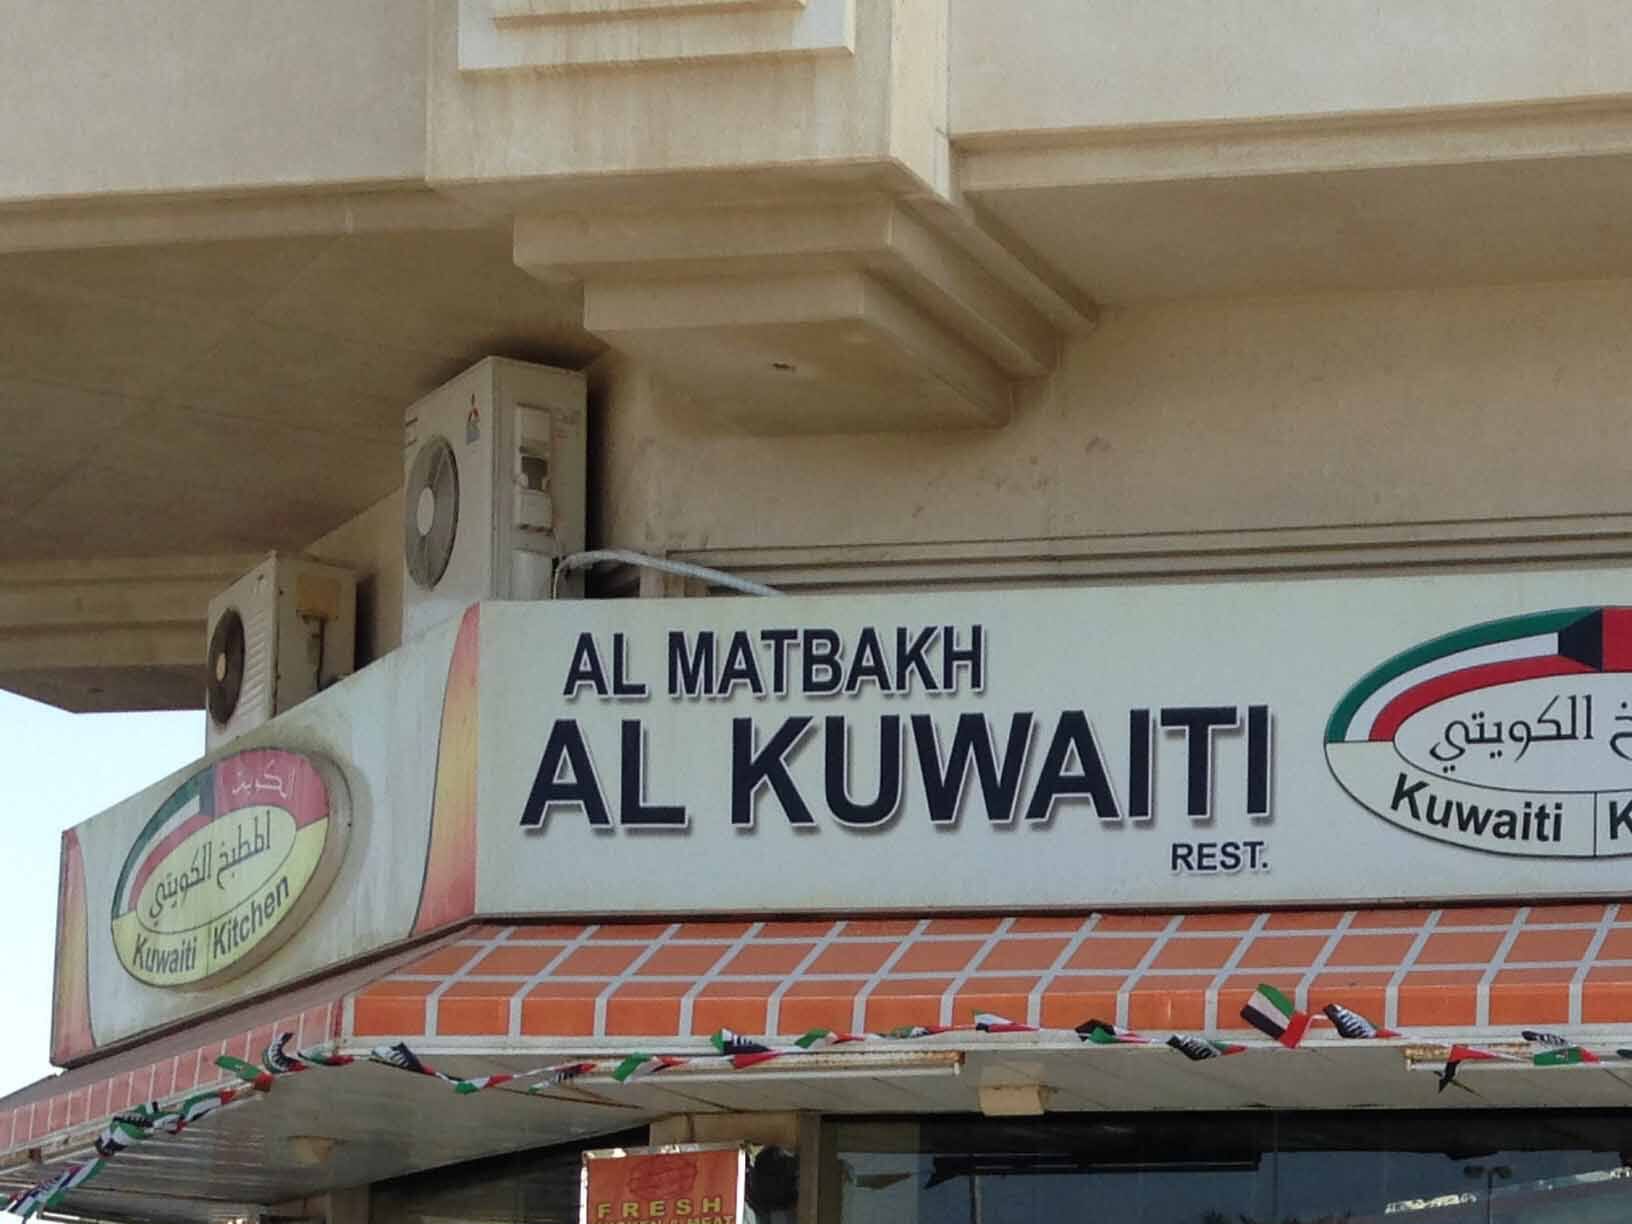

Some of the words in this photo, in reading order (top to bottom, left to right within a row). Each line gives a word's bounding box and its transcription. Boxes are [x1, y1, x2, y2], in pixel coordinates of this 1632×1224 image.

[562, 630, 647, 697] AL
[666, 623, 985, 697] MATBAKH
[519, 717, 688, 828] AL
[730, 704, 1271, 828] KUWAITI
[1429, 693, 1595, 774] الكويتي
[1390, 772, 1563, 843] Kuwaiti
[148, 840, 212, 928] الكويتي
[216, 809, 271, 892] المطبخ
[1170, 840, 1270, 873] REST.
[132, 932, 198, 975] Kuwaiti
[212, 875, 290, 961] Kitchen
[597, 1197, 722, 1219] FRESH
